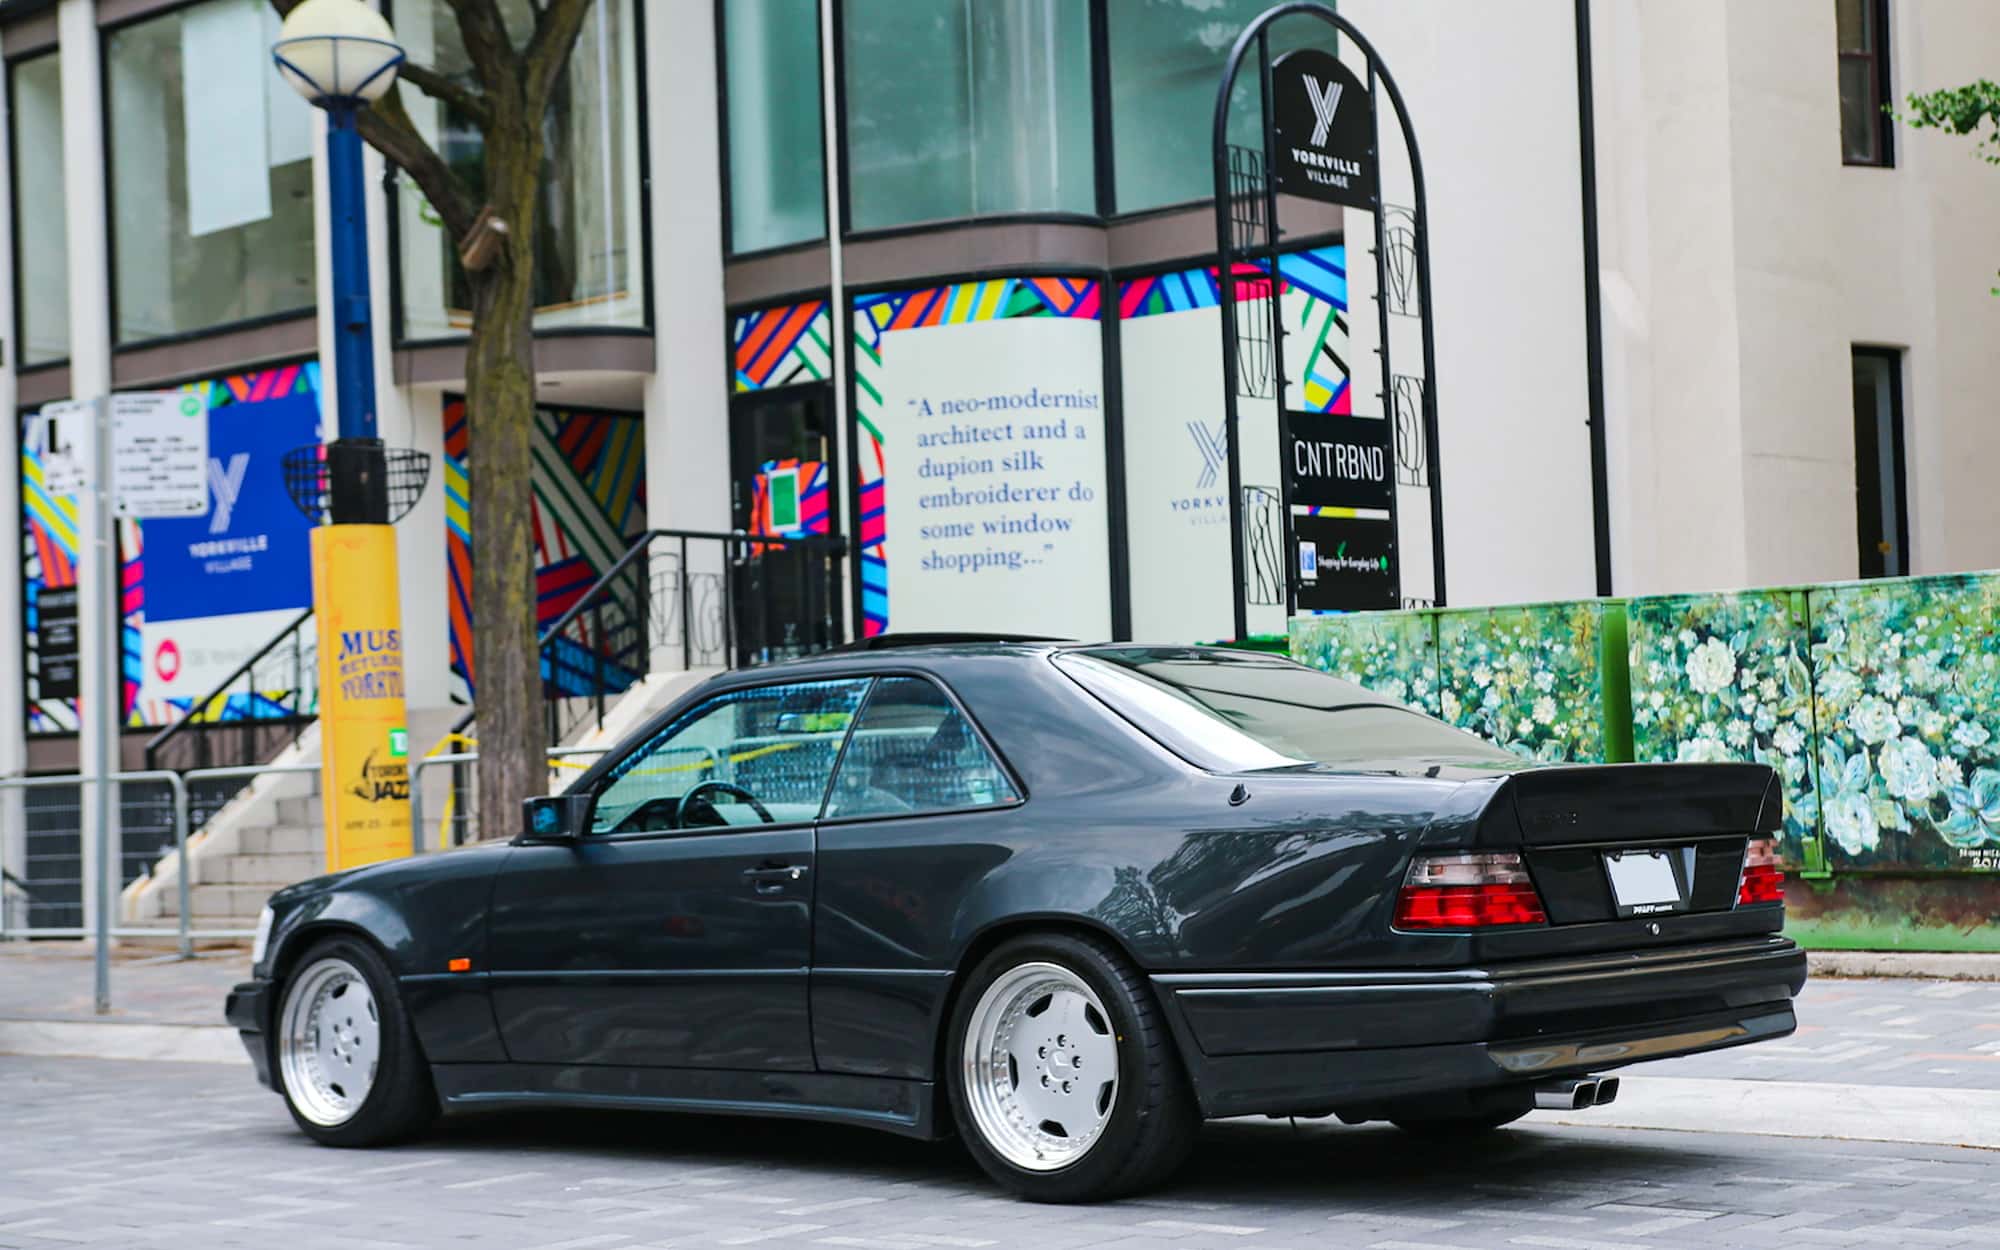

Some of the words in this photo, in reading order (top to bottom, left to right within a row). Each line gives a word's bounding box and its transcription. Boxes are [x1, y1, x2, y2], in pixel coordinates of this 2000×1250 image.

[1292, 148, 1361, 176] YORKVILLE
[1306, 169, 1349, 189] VILLAGE
[941, 387, 1098, 415] neo-modernist
[917, 424, 1013, 447] architect
[1023, 418, 1067, 439] and
[1075, 425, 1086, 440] a
[918, 457, 994, 481] dupion
[1002, 450, 1044, 472] silk
[1294, 440, 1384, 482] CNTRBND
[919, 483, 1060, 509] embroiderer
[1068, 481, 1094, 502] do
[920, 521, 975, 539] some
[982, 512, 1072, 534] window
